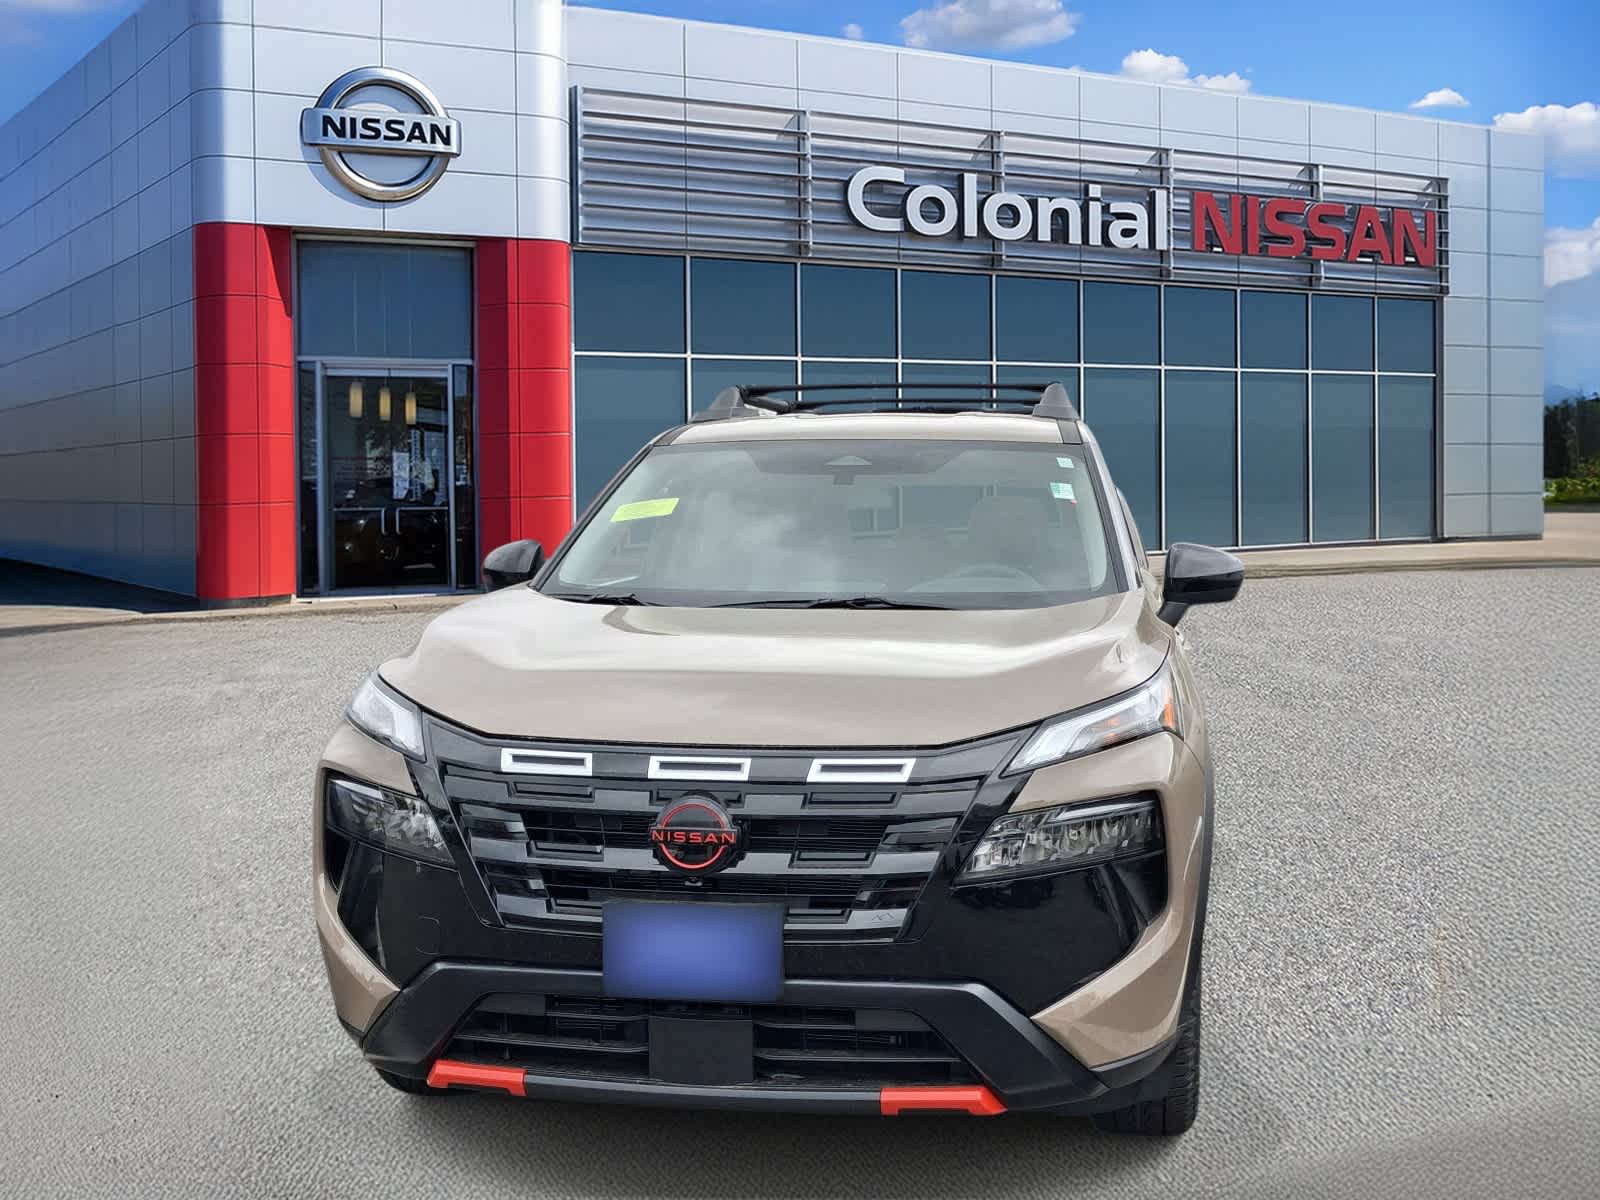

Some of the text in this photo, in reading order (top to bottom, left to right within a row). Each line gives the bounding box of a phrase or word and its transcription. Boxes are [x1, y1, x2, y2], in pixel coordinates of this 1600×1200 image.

[322, 115, 451, 147] NISSAN
[846, 165, 1436, 267] Colonial NISSAN
[651, 830, 737, 844] NISSAN
